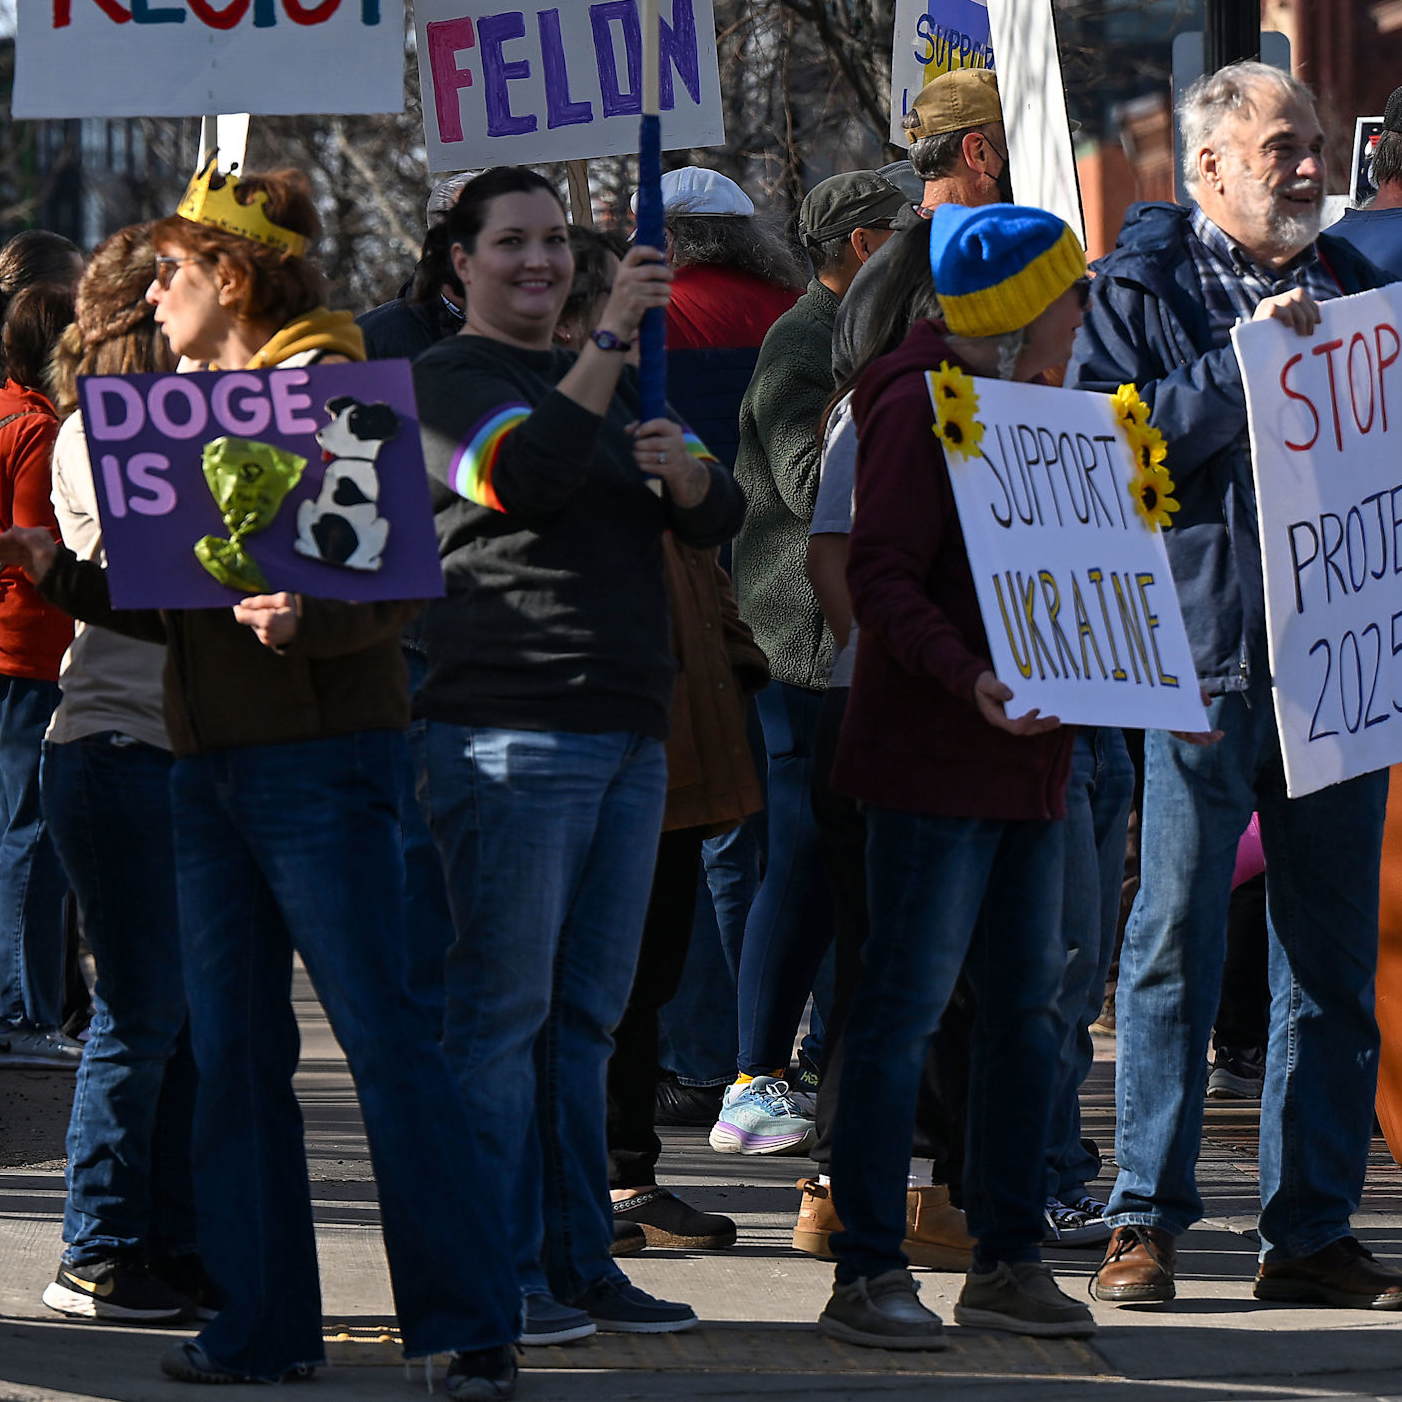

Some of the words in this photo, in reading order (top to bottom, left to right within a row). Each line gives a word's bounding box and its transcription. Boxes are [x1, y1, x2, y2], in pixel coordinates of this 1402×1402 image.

[83, 369, 318, 442] DOGE
[1279, 322, 1401, 453] STOP
[101, 452, 177, 519] IS
[979, 422, 1128, 530] SUPPORT
[992, 567, 1180, 689] UKRAINE
